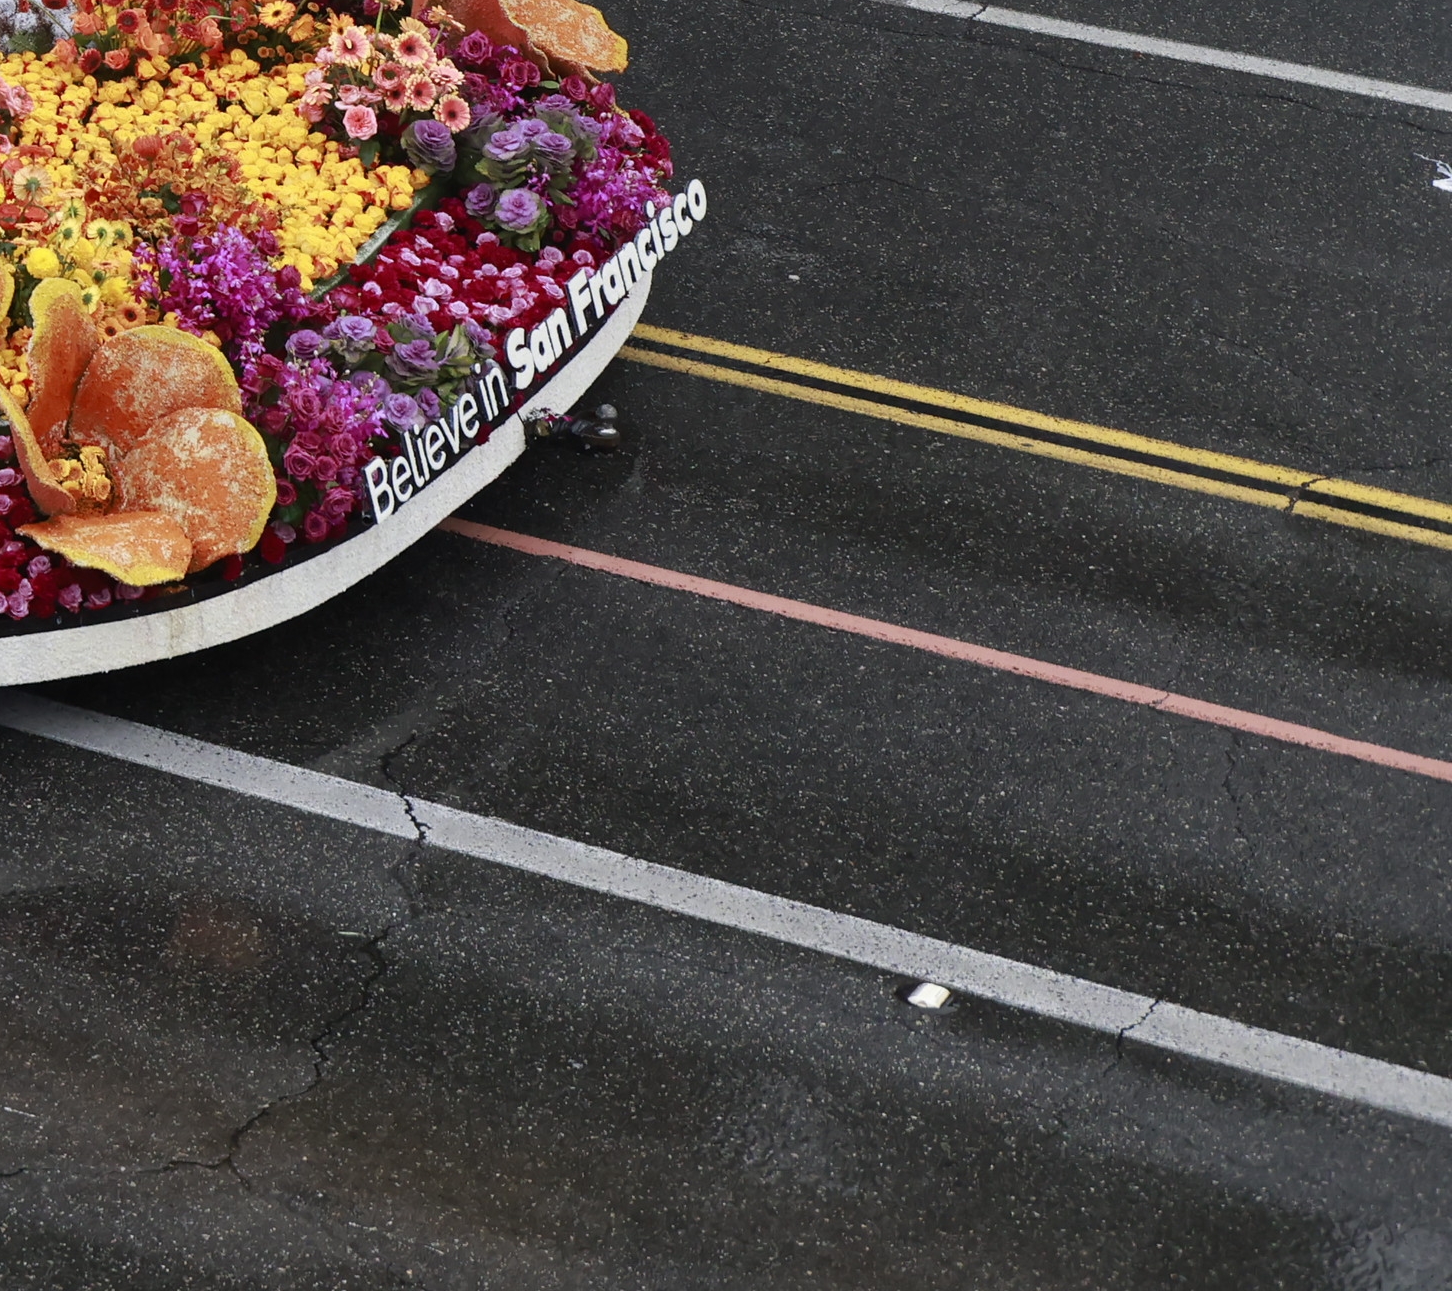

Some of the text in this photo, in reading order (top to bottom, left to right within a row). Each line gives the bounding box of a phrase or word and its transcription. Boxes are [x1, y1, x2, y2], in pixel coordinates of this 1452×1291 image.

[363, 178, 708, 525] Believe in San Francisco
